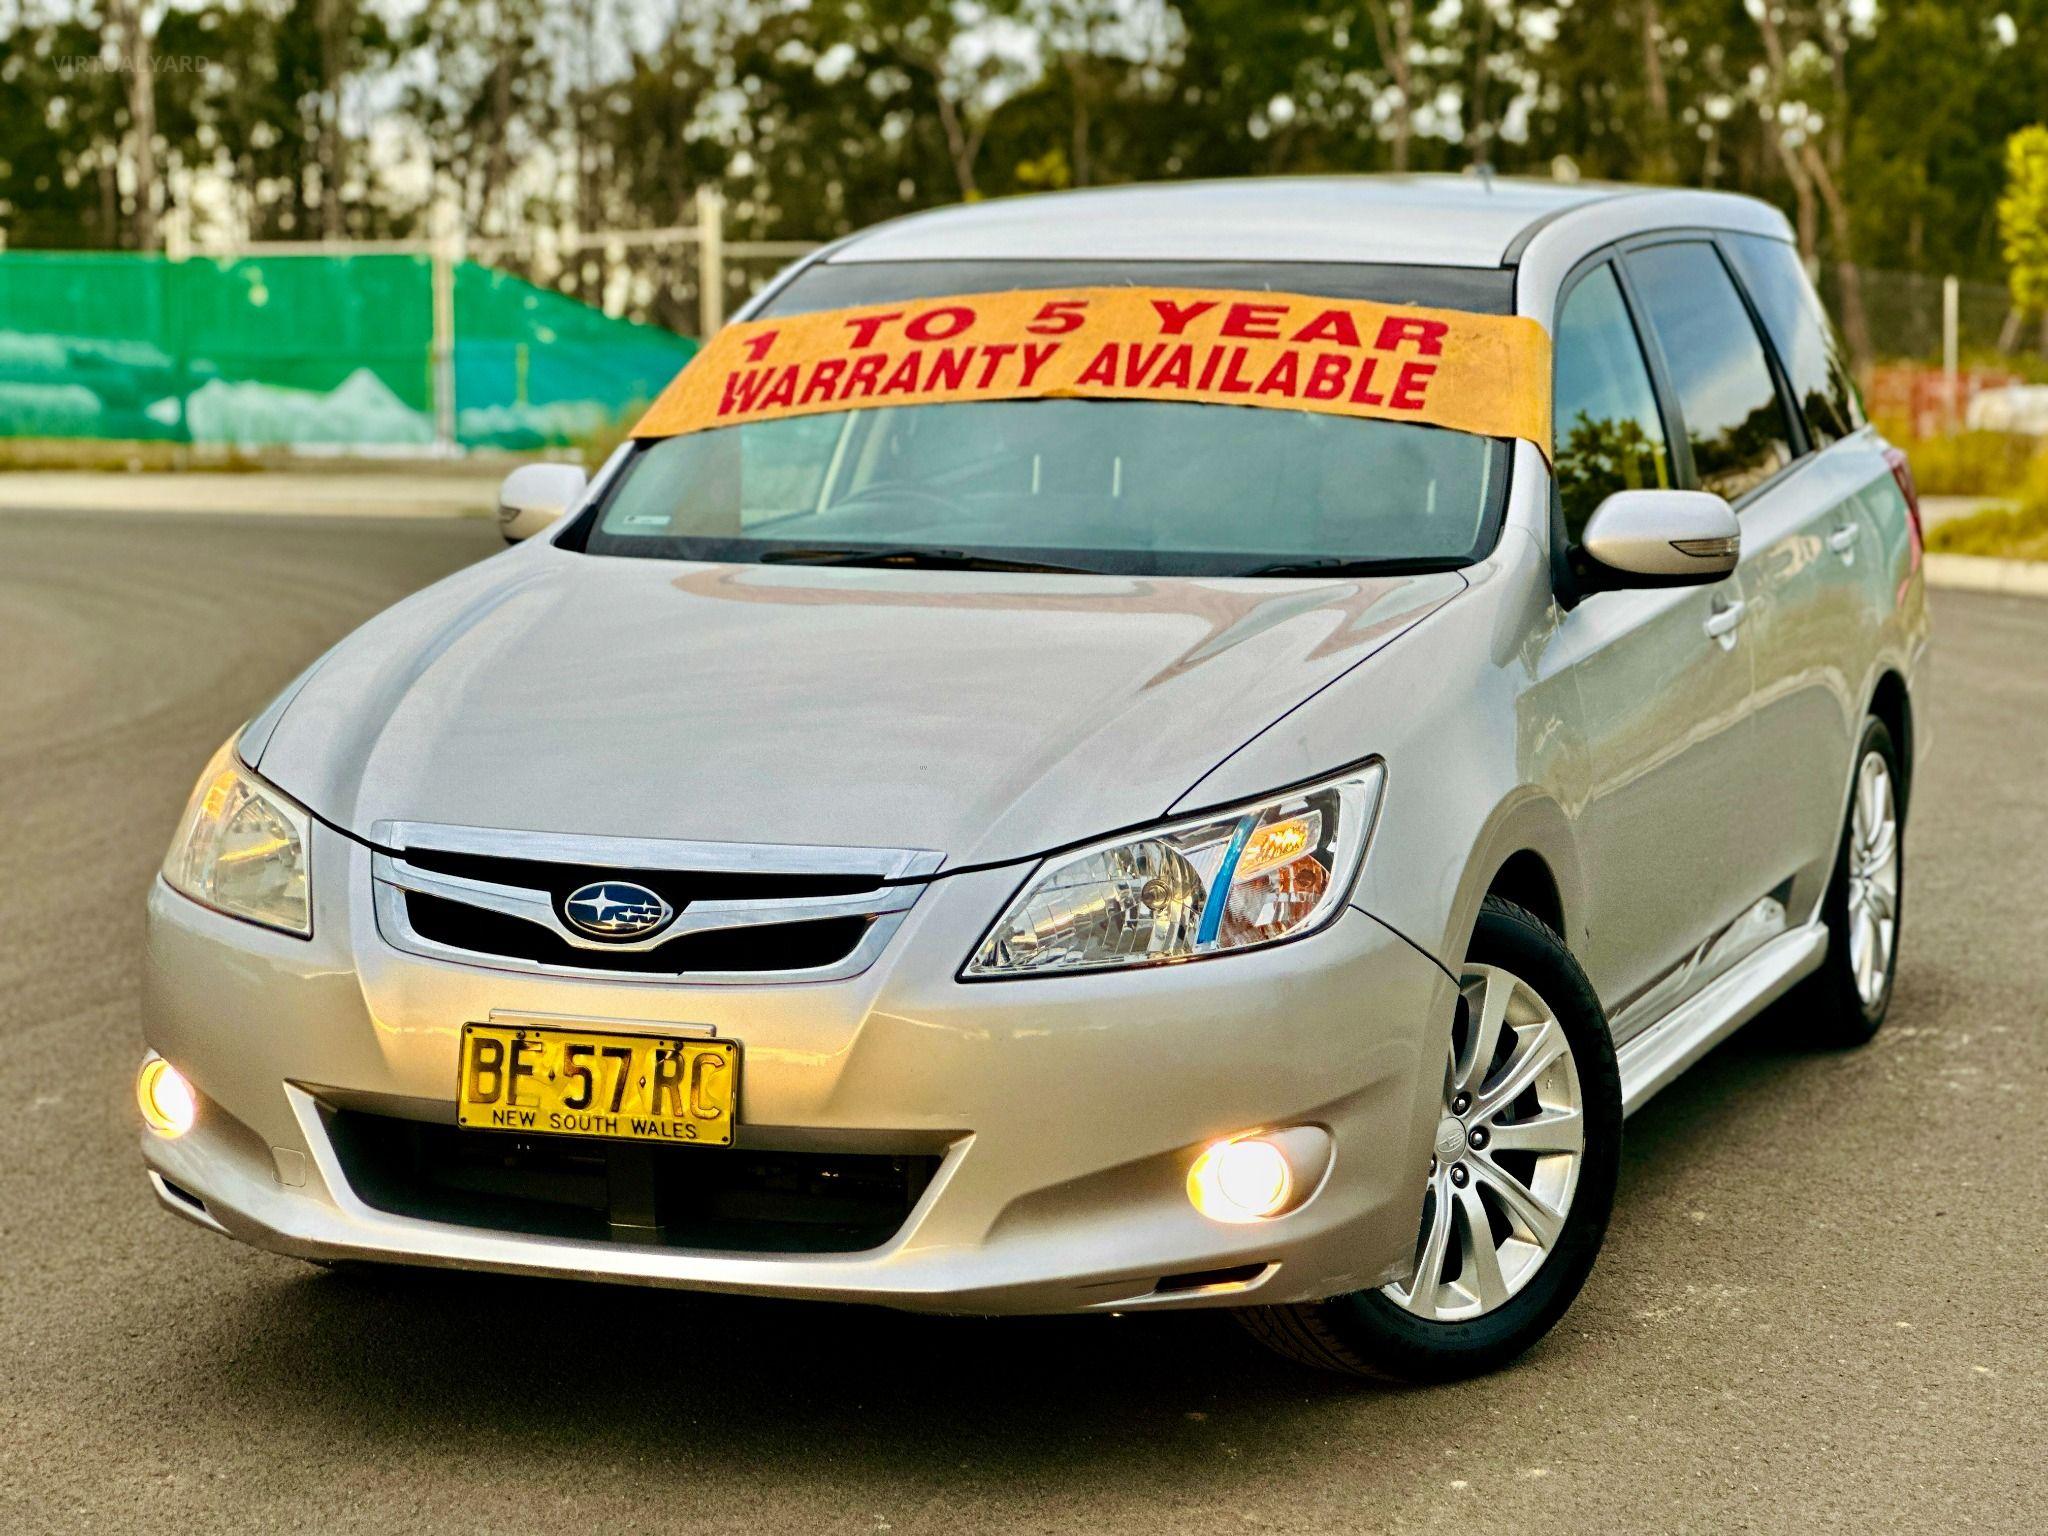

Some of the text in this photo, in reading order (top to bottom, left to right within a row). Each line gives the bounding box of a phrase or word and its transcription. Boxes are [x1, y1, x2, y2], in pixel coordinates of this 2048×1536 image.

[742, 300, 1450, 363] 1 TO 5 YEAR
[717, 342, 1438, 417] WARRANTY AVAILABLE
[492, 1109, 698, 1140] NEW SOUTH WALES
